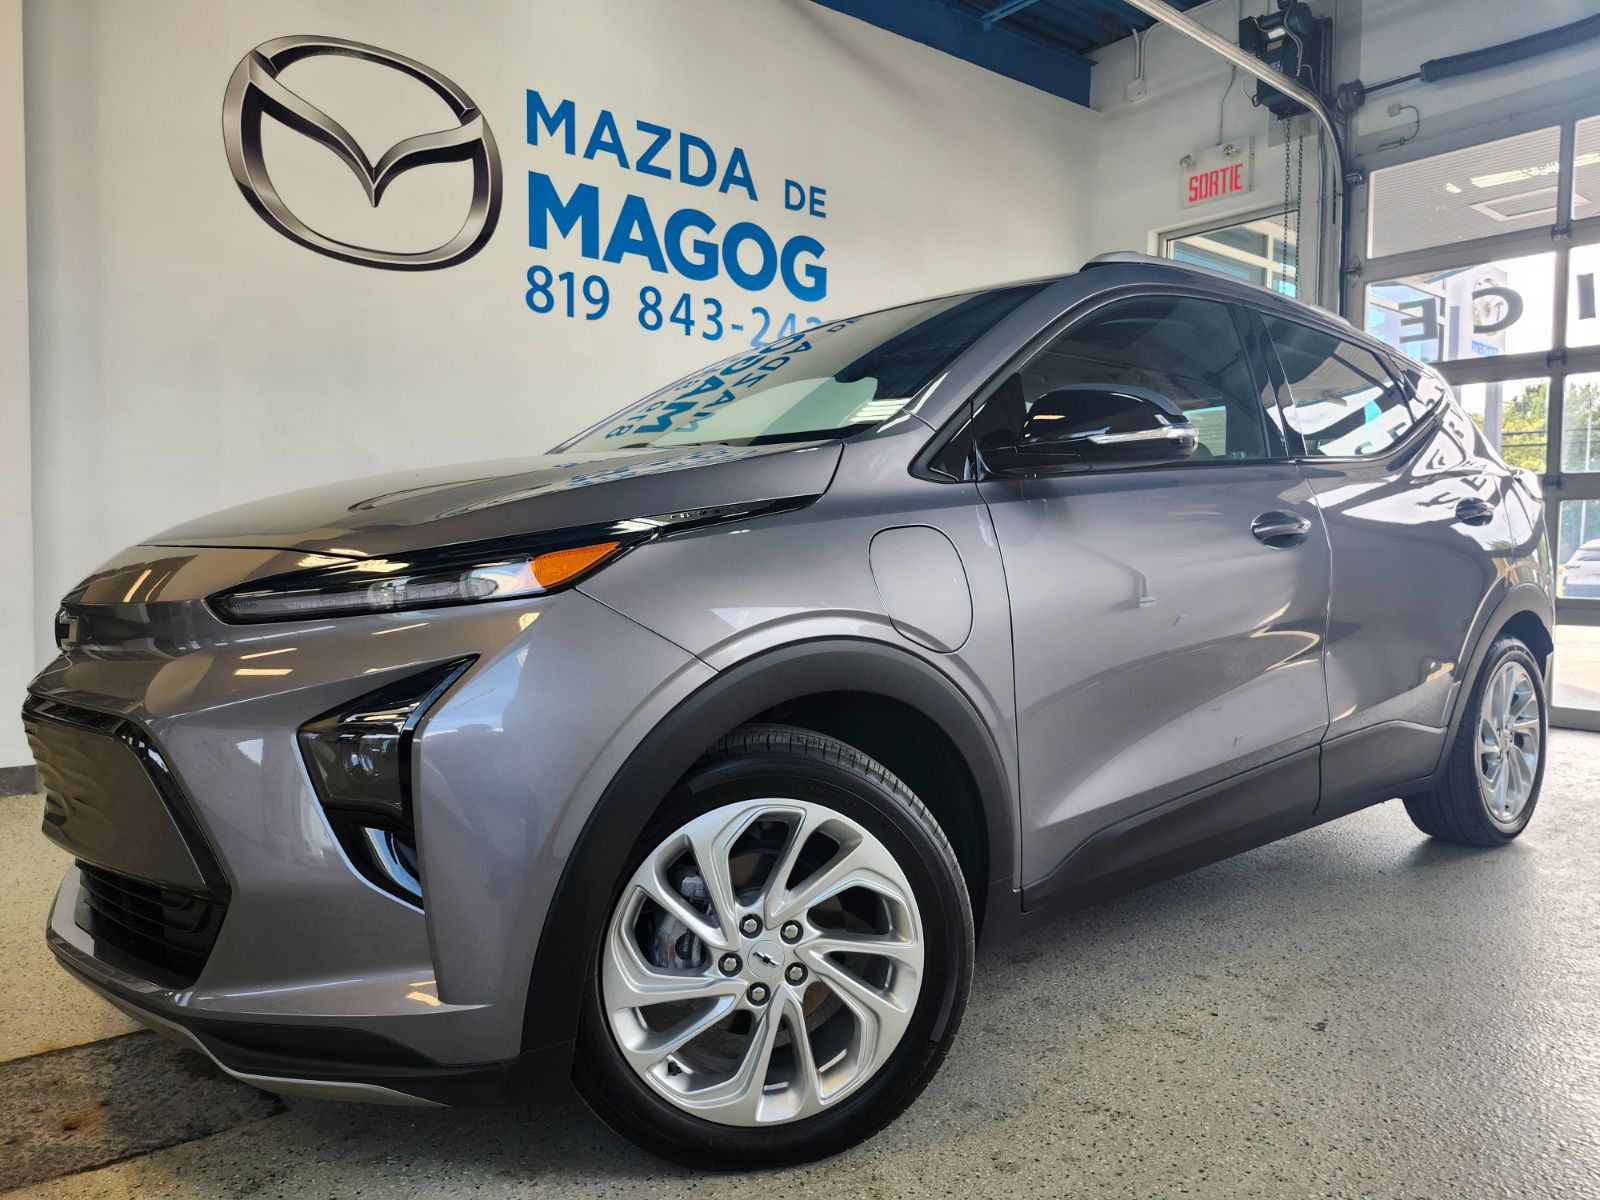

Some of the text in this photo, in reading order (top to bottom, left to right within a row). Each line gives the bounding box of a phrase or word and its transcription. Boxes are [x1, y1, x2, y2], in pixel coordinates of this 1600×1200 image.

[525, 88, 827, 219] MAZDA DE
[1188, 162, 1244, 203] SORTIE
[527, 169, 827, 303] MAGOG
[525, 263, 611, 321] 819
